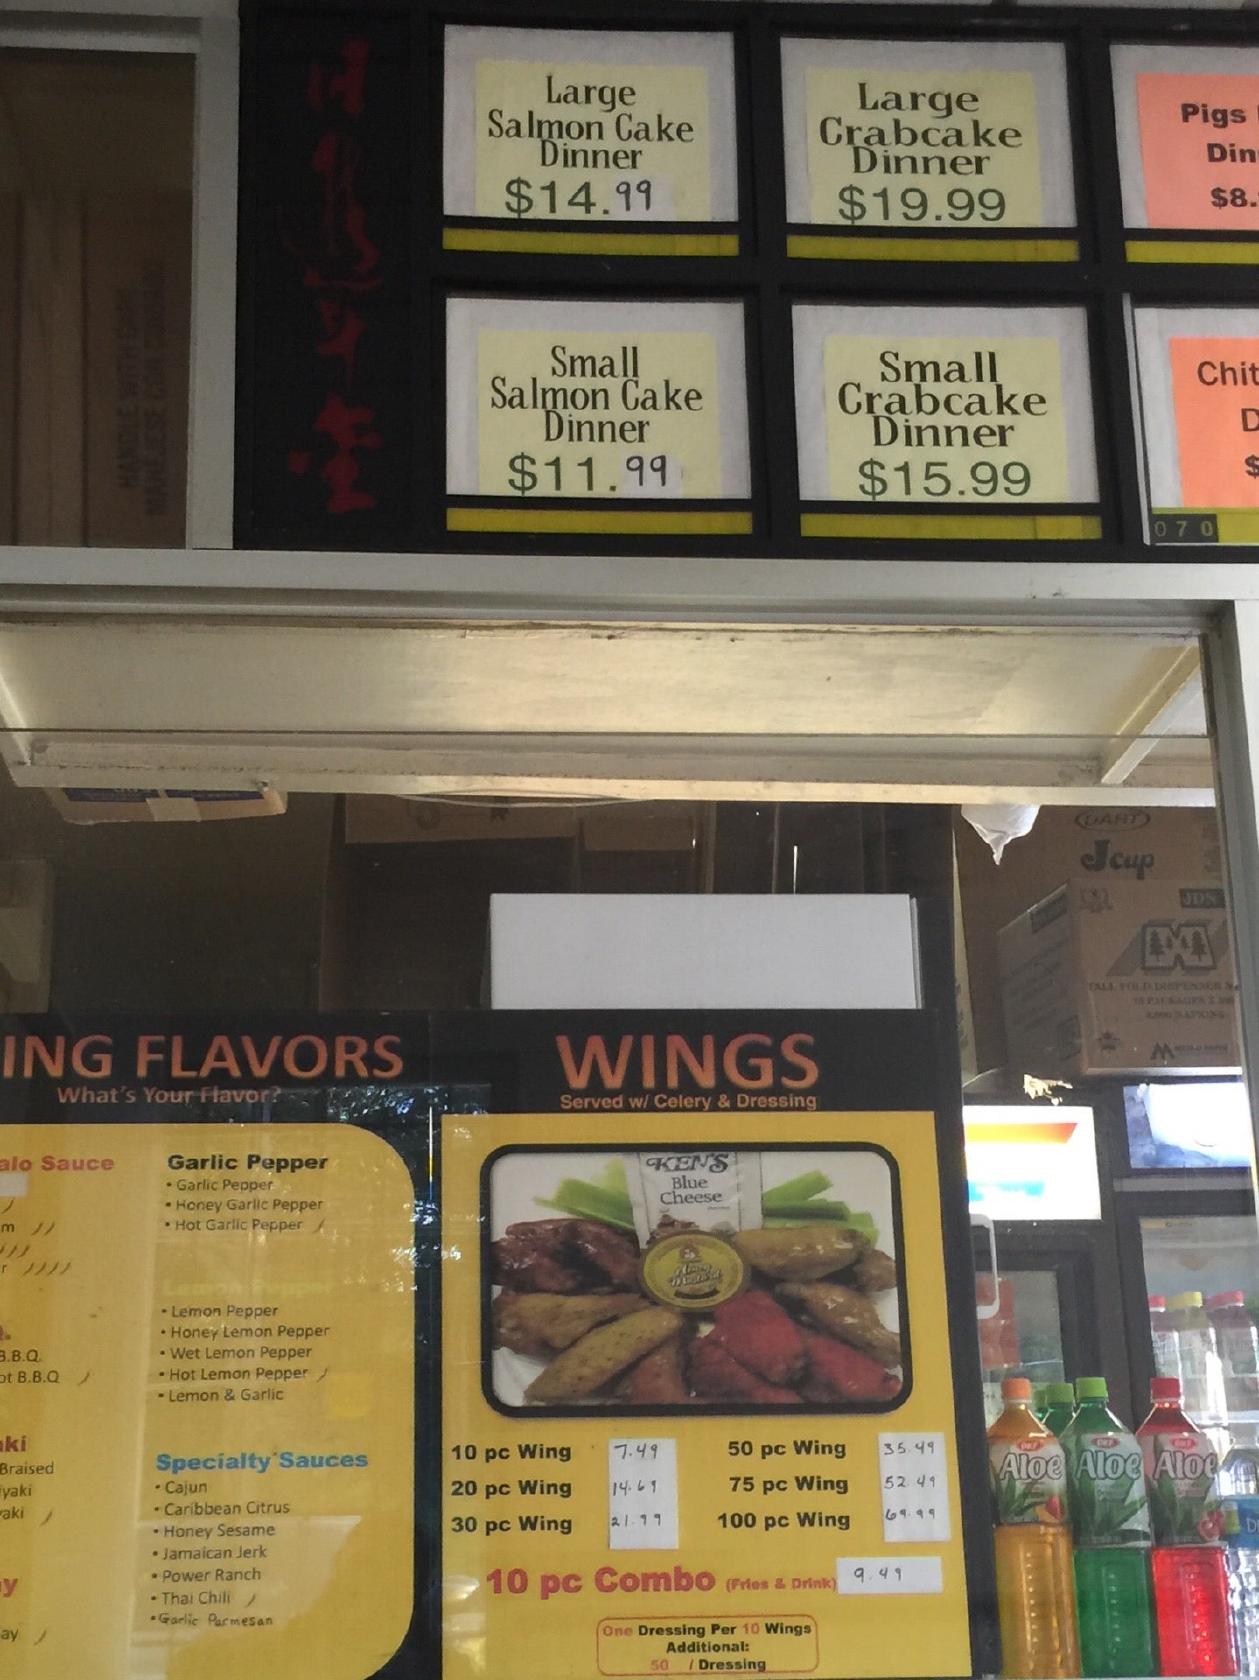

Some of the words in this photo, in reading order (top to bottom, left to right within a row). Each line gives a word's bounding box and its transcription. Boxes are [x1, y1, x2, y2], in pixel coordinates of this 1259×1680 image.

[547, 75, 636, 112] Large
[858, 82, 979, 118] Large
[1181, 103, 1246, 128] Pigs
[488, 109, 604, 140] Salmon
[615, 113, 694, 143] Cake
[819, 117, 1023, 148] Crabcake
[540, 139, 643, 170] Dinner
[852, 146, 991, 175] Dinner
[1207, 143, 1259, 163] Din
[505, 177, 652, 218] $14.99
[838, 184, 1006, 224] $19.99
[1211, 187, 1259, 210] $8.
[551, 345, 639, 378] Small
[879, 351, 997, 384] Small
[491, 376, 610, 410] Salmon
[622, 379, 703, 411] Cake
[838, 382, 1047, 416] Crabcake
[545, 410, 650, 443] Dinner
[873, 415, 1014, 448] Dinner
[508, 452, 667, 497] $11.99
[858, 458, 1031, 500] $15.99
[137, 1035, 403, 1079] FLAVORS
[556, 1033, 819, 1090] WINGS
[57, 1086, 136, 1104] What's
[144, 1087, 193, 1105] Your
[200, 1086, 281, 1104] Flavor?
[560, 1094, 624, 1109] Served
[629, 1094, 649, 1109] w/
[654, 1094, 710, 1111] Celery
[718, 1094, 730, 1109] &
[737, 1093, 817, 1110] Dressing
[41, 1155, 114, 1171] Sauce
[168, 1155, 238, 1170] Garlic
[247, 1155, 329, 1173] Pepper
[177, 1179, 218, 1191] Garlic
[223, 1179, 273, 1192] Pepper
[672, 1175, 709, 1190] Blue
[176, 1200, 222, 1213] Honey
[227, 1199, 268, 1211] Garlic
[273, 1199, 323, 1213] Pepper
[660, 1191, 723, 1205] Cheese
[175, 1220, 201, 1231] Hot
[206, 1219, 247, 1231] Garlic
[252, 1219, 302, 1233] Pepper
[172, 1305, 221, 1318] Lemon
[227, 1305, 278, 1319] Pepper
[171, 1326, 219, 1341] Honey
[223, 1325, 273, 1338] Lemon
[278, 1325, 330, 1340] Pepper
[170, 1347, 200, 1360] Wet
[205, 1347, 255, 1360] Lemon
[260, 1346, 312, 1361] Pepper
[169, 1368, 197, 1381] Hot
[201, 1368, 250, 1381] Lemon
[256, 1367, 308, 1382] Pepper
[169, 1389, 219, 1402] Lemon
[224, 1388, 235, 1401] &
[240, 1388, 284, 1401] Garlic
[451, 1444, 477, 1460] 10
[485, 1447, 510, 1463] pc
[518, 1444, 571, 1462] Wing
[614, 1443, 658, 1460] 7.49
[728, 1440, 753, 1456] 50
[761, 1443, 786, 1460] pc
[793, 1440, 846, 1459] Wing
[884, 1441, 935, 1456] 35.49
[0, 1461, 54, 1475] Braised
[156, 1452, 271, 1474] Specialty
[279, 1452, 368, 1468] Sauces
[1001, 1452, 1064, 1480] Aloe
[1075, 1450, 1141, 1480] Aloe
[1152, 1450, 1219, 1480] Aloe
[165, 1481, 208, 1496] Cajun
[451, 1480, 478, 1496] 20
[485, 1483, 511, 1500] pc
[518, 1480, 572, 1498] Wing
[612, 1479, 656, 1496] 14.69
[729, 1476, 755, 1492] 75
[763, 1479, 788, 1495] pc
[795, 1476, 849, 1494] Wing
[884, 1474, 936, 1489] 52.49
[0, 1484, 32, 1500] yaki
[164, 1502, 242, 1516] Caribbean
[246, 1501, 290, 1514] Citrus
[885, 1508, 936, 1521] 69.99
[451, 1516, 478, 1533] 30
[485, 1519, 511, 1536] pc
[518, 1516, 573, 1535] Wing
[718, 1512, 756, 1529] 100
[764, 1514, 789, 1531] pc
[796, 1512, 850, 1531] Wing
[164, 1525, 213, 1540] Honey
[217, 1524, 275, 1537] Sesame
[163, 1547, 232, 1560] Jamaican
[237, 1545, 268, 1559] Jerk
[162, 1570, 211, 1583] Power
[215, 1568, 261, 1581] Ranch
[486, 1568, 529, 1595] 10
[540, 1573, 582, 1600] pc
[594, 1566, 716, 1594] Combo
[725, 1578, 769, 1593] (Fries
[775, 1578, 786, 1590] &
[791, 1577, 837, 1592] Drink)
[853, 1567, 902, 1584] 9.49
[162, 1592, 193, 1605] Thai
[198, 1591, 231, 1604] Chili
[159, 1613, 198, 1626] Garlic
[209, 1613, 273, 1627] Parmesan
[602, 1626, 633, 1638] One
[638, 1624, 705, 1639] Dressing
[711, 1623, 737, 1635] Per
[743, 1622, 760, 1635] 10
[765, 1622, 812, 1637] Wings
[666, 1641, 750, 1655] Additional:
[650, 1660, 669, 1671] 50
[698, 1658, 767, 1673] Dressing
